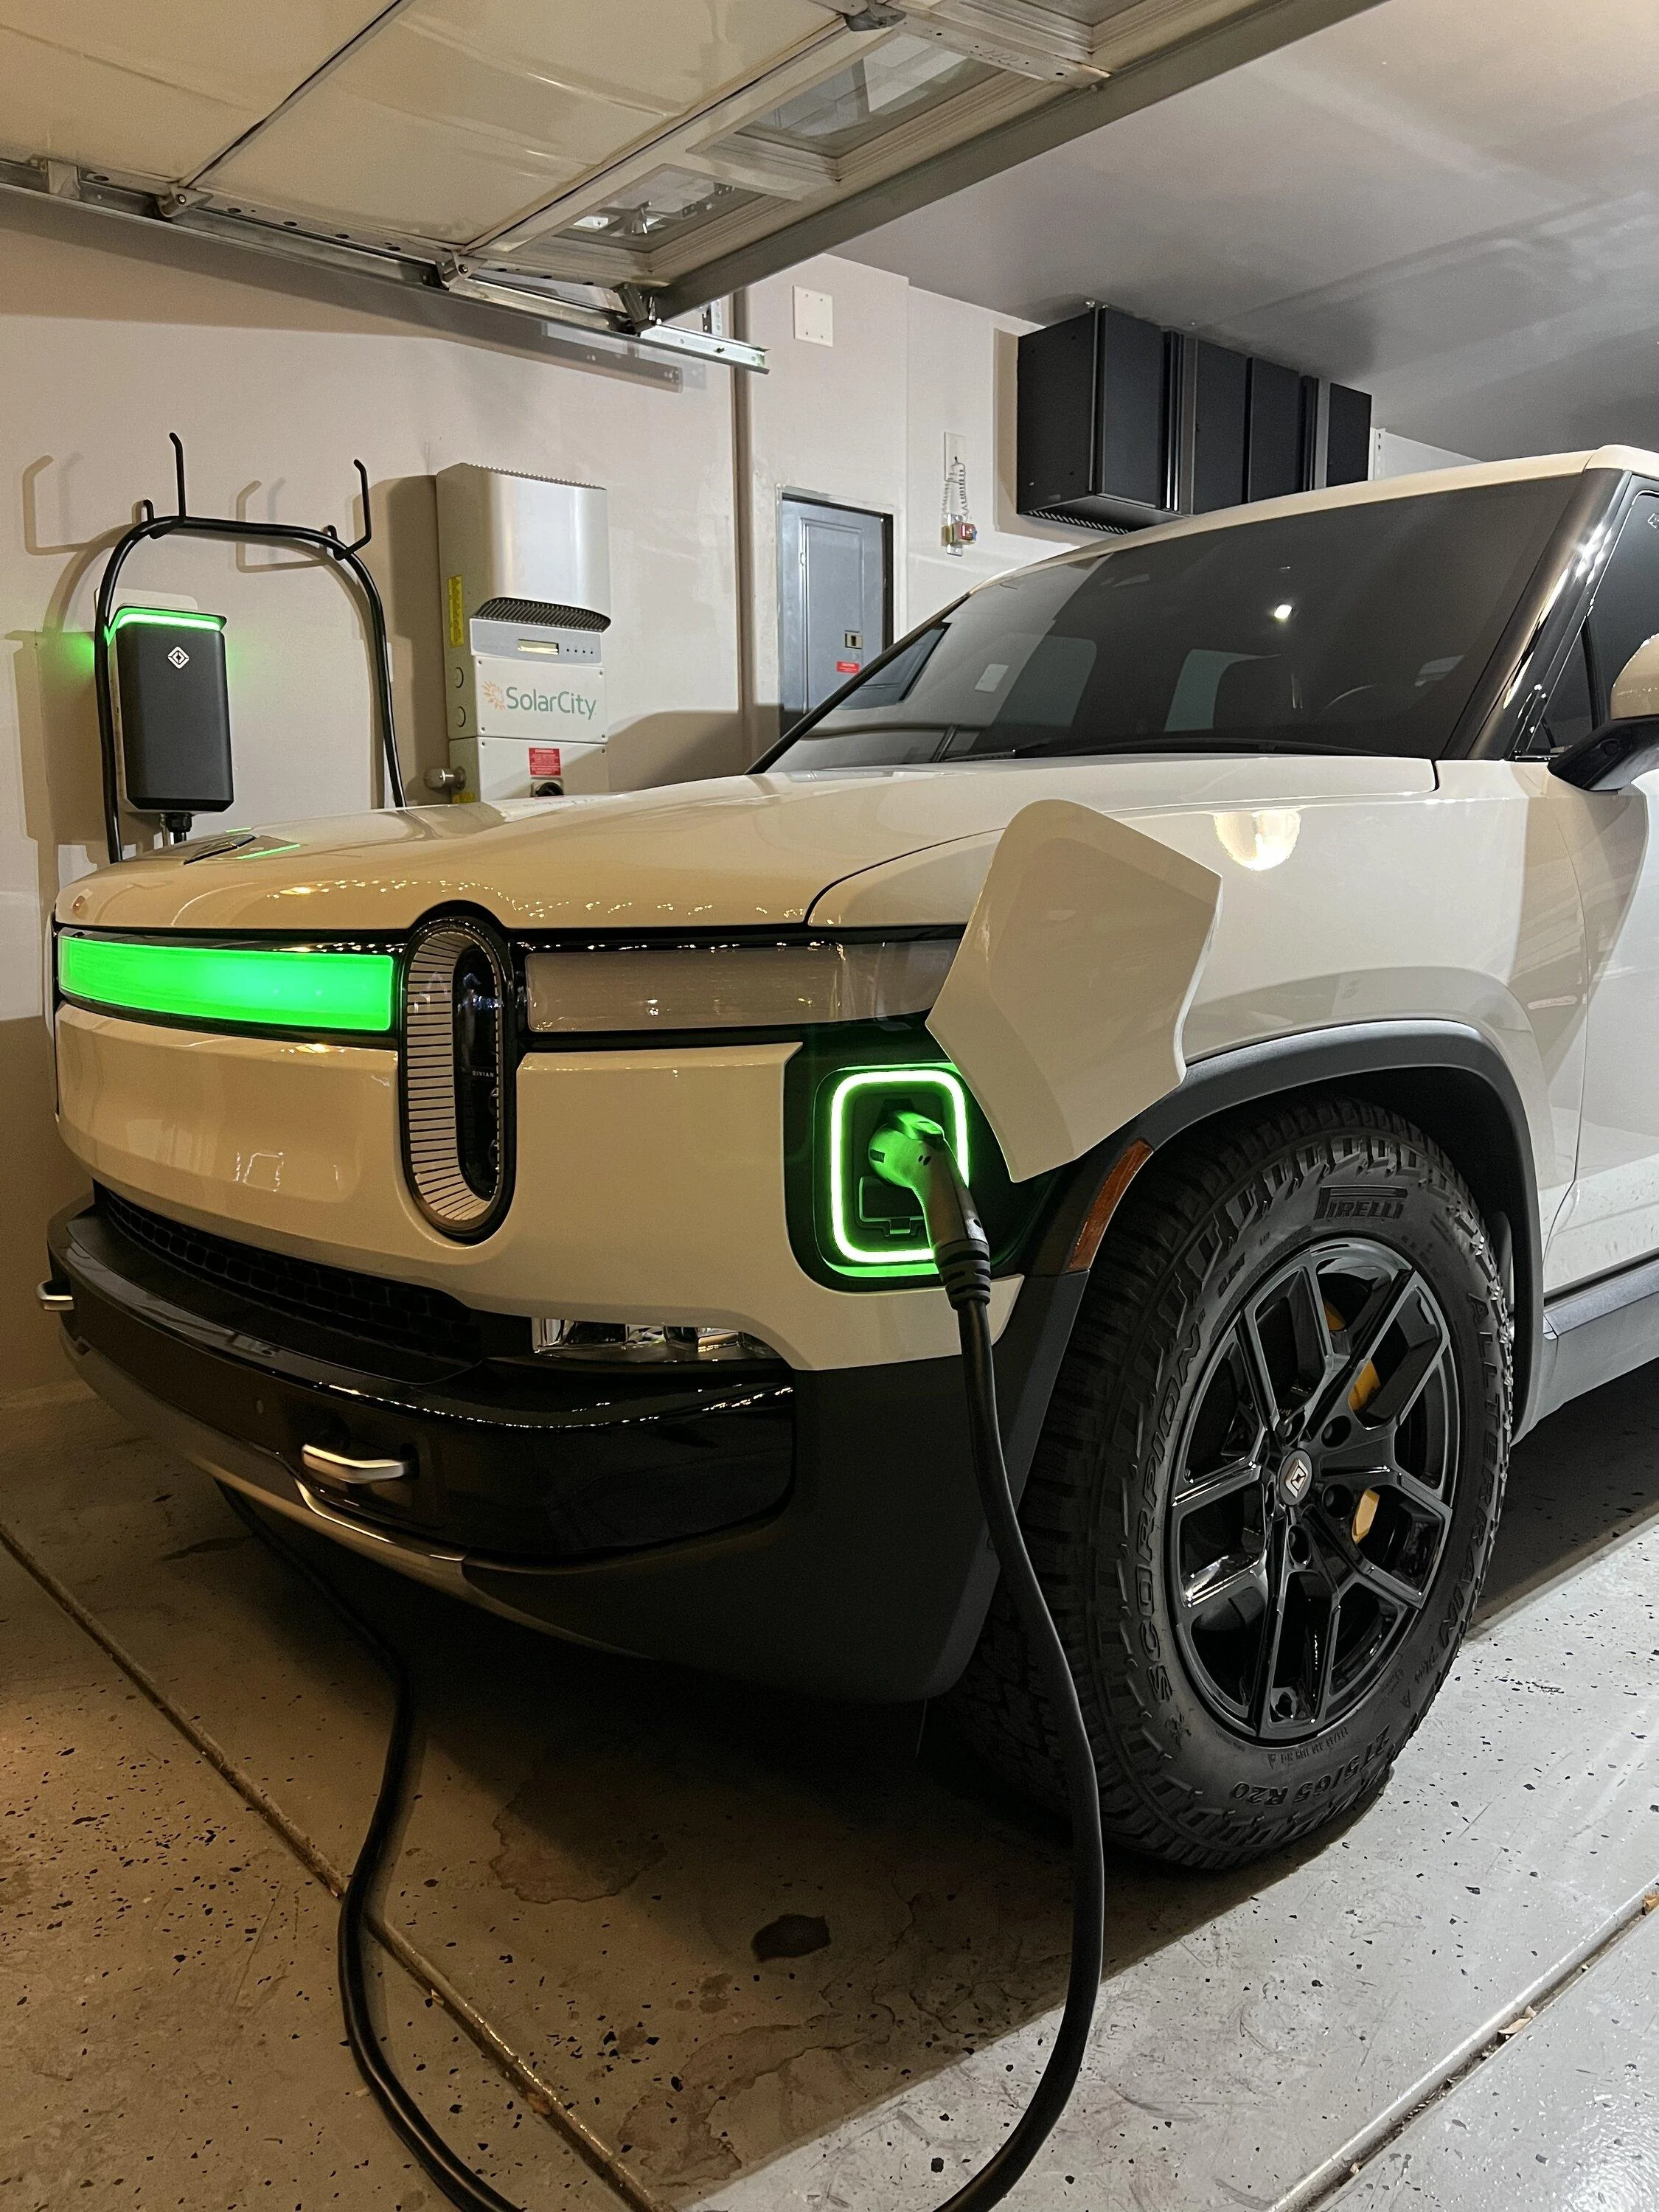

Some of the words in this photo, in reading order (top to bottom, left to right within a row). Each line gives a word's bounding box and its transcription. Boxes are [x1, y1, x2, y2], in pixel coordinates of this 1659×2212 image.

[506, 686, 597, 720] SolarCity
[1314, 1185, 1408, 1220] PIRELLI
[1467, 1293, 1498, 1388] ALL
[1135, 1321, 1201, 1703] SCORPION
[1439, 1392, 1500, 1649] TERRAIN
[1231, 1781, 1289, 1806] R20
[1293, 1724, 1390, 1804] 275/65
